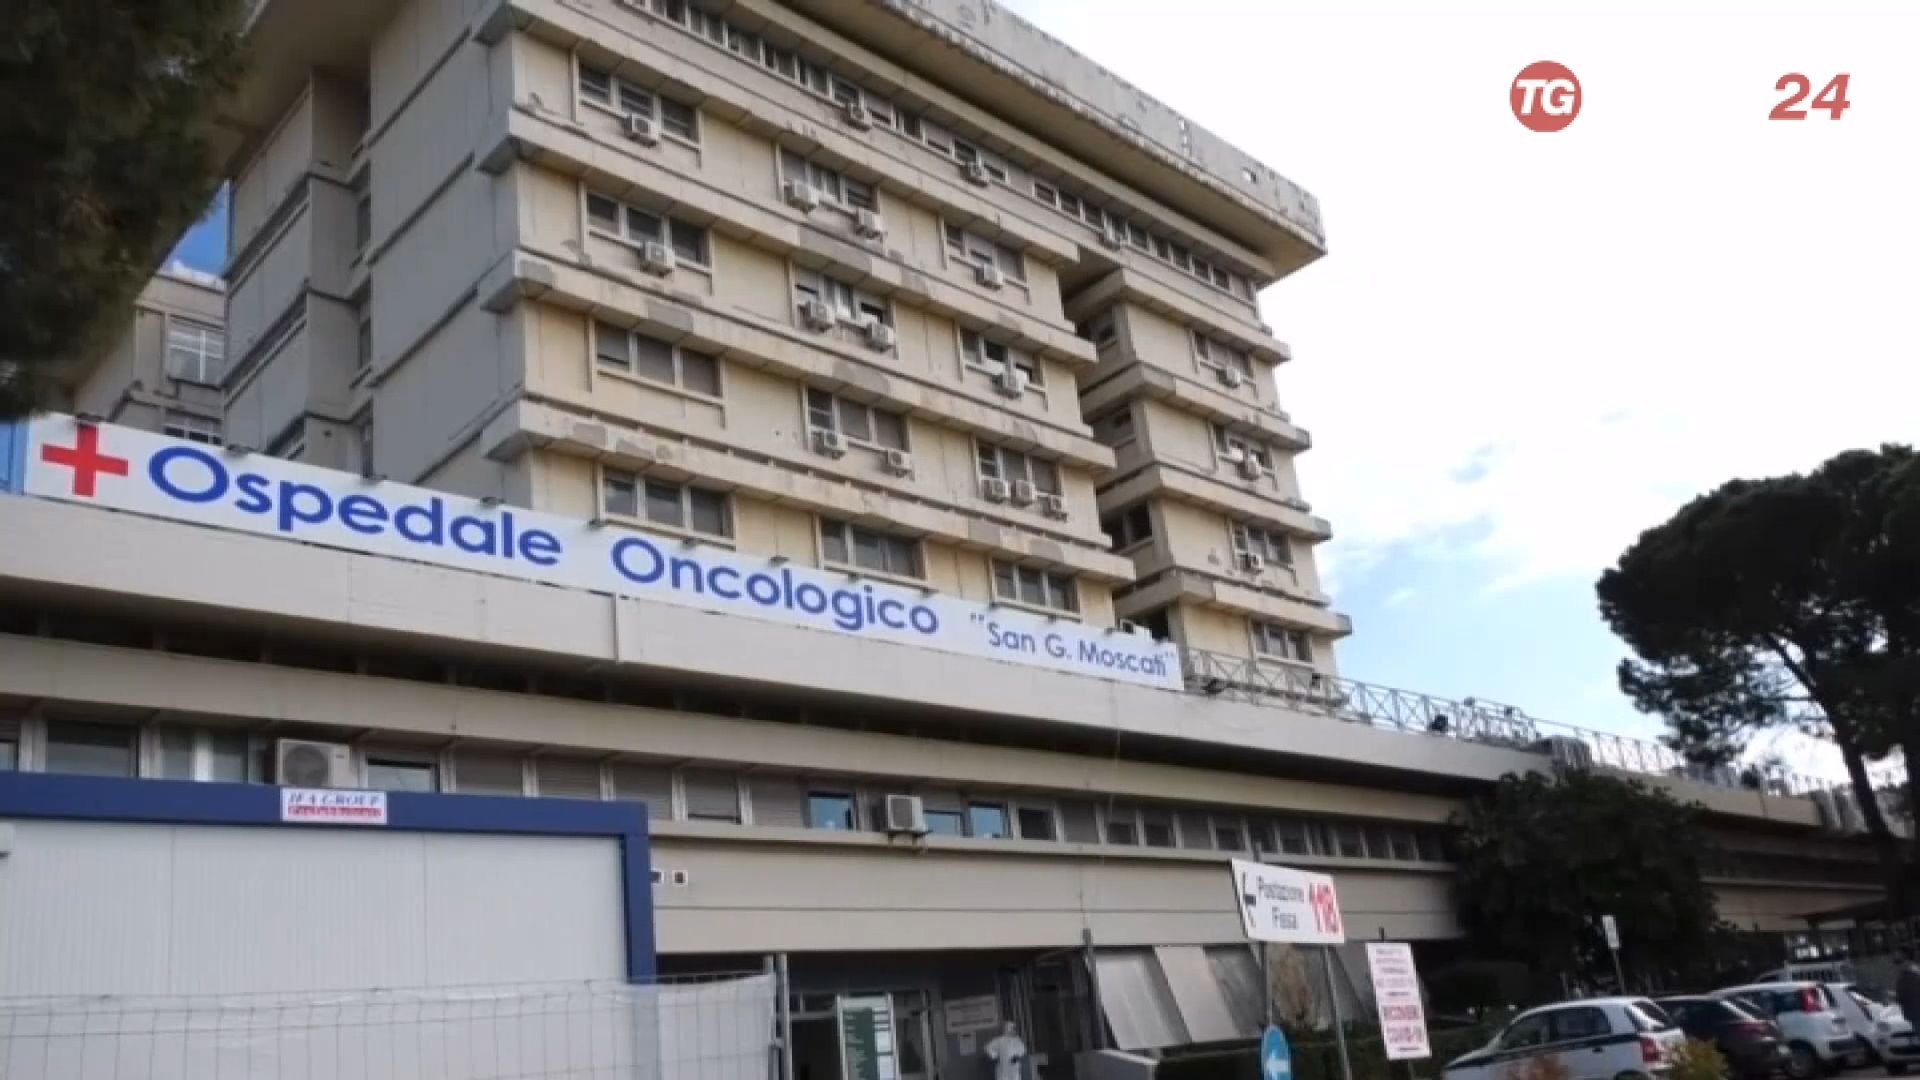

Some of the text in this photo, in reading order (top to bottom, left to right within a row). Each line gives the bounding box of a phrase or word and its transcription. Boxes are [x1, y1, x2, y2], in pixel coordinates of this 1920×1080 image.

[148, 446, 563, 566] Ospedale
[611, 537, 938, 634] Oncologico
[1044, 633, 1072, 660] G.
